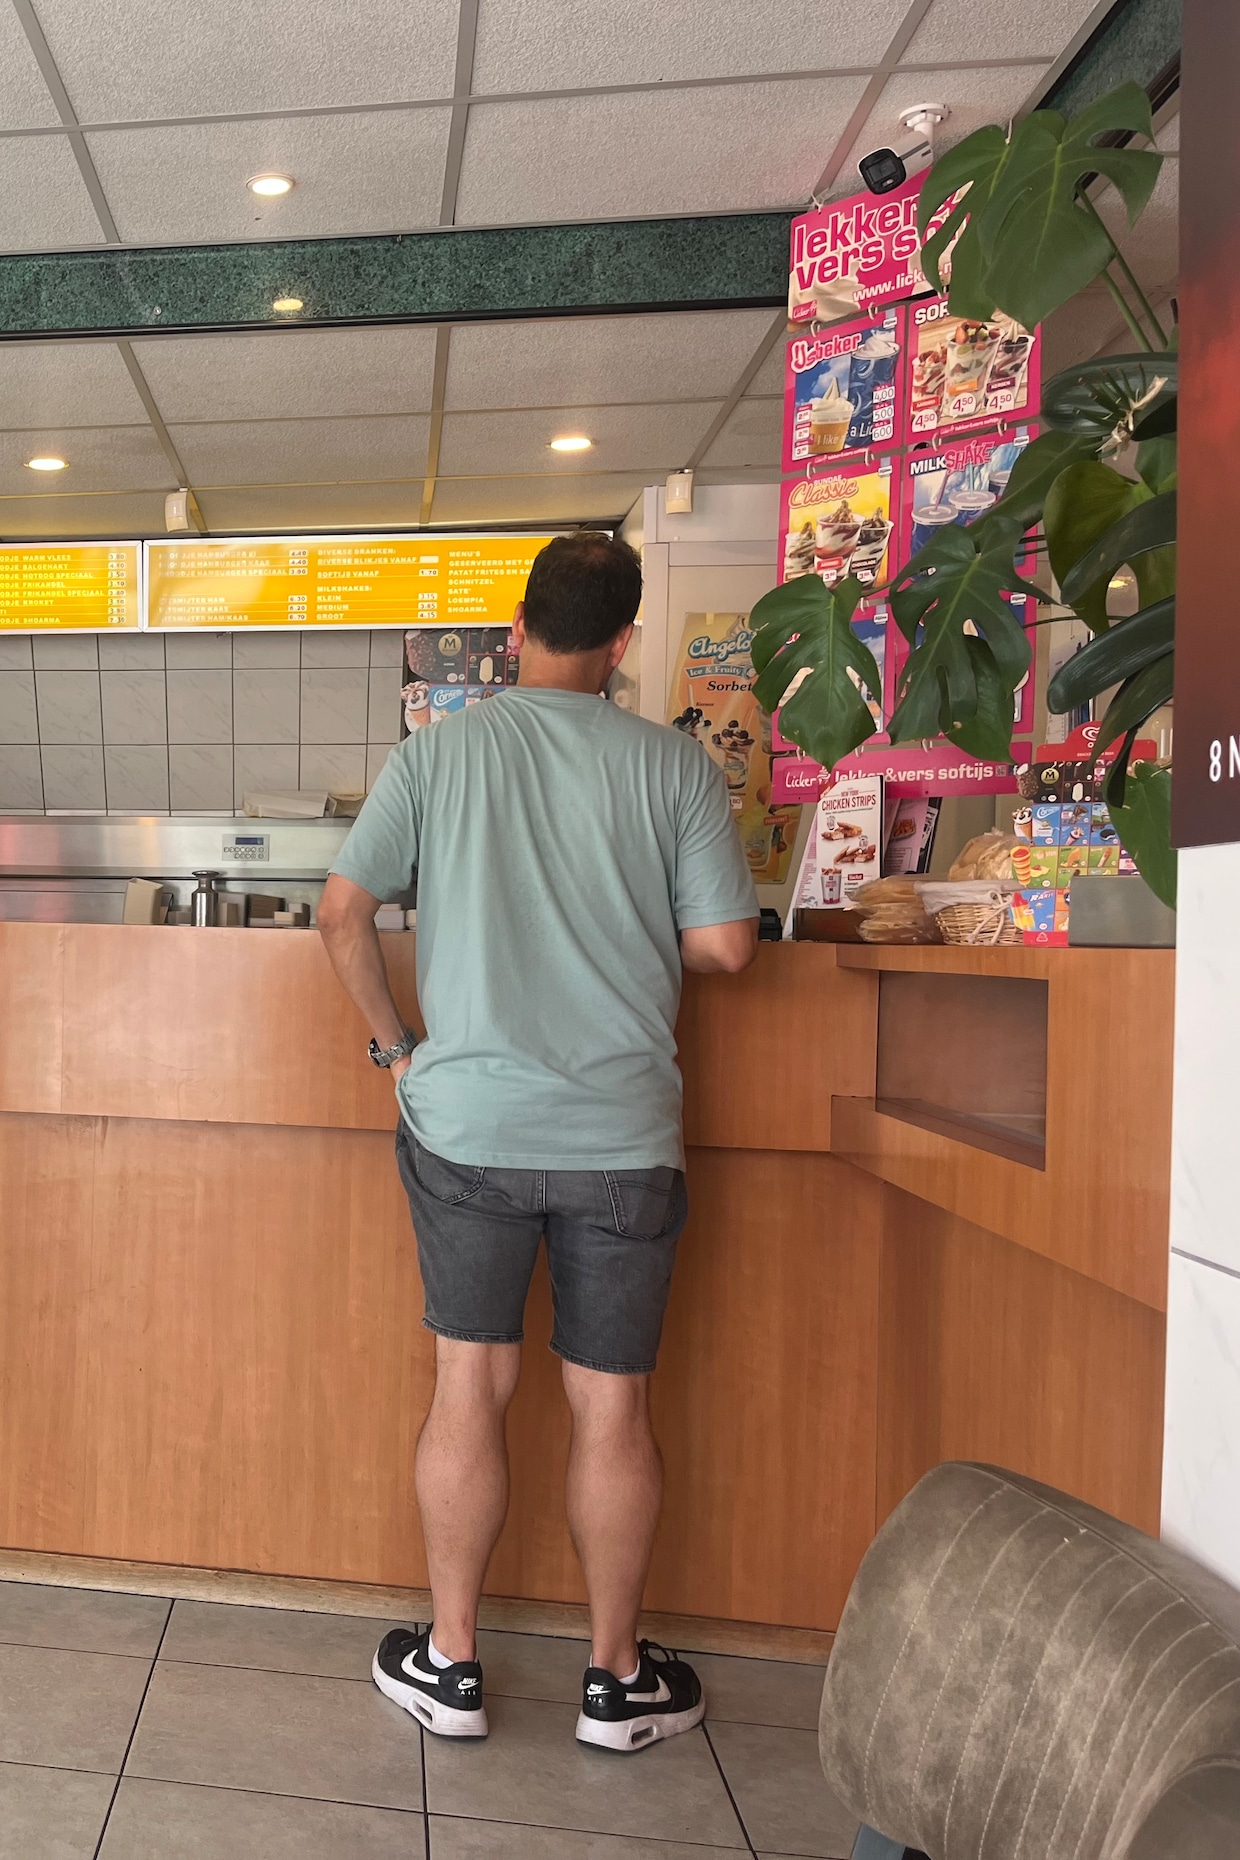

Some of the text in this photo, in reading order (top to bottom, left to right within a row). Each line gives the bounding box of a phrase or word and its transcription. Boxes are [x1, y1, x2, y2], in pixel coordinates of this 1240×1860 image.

[795, 239, 886, 292] vers
[953, 396, 974, 412] 4,50
[989, 394, 1012, 410] 4,50
[915, 414, 935, 429] 4,50
[788, 478, 859, 509] Classic
[354, 557, 388, 565] BLIKJES
[714, 666, 741, 675] Fruity
[1209, 739, 1222, 782] 8
[785, 763, 994, 788] Licker softijs
[821, 797, 851, 811] CHICKEN
[851, 794, 877, 808] STRIPS
[461, 1677, 478, 1686] NIKE
